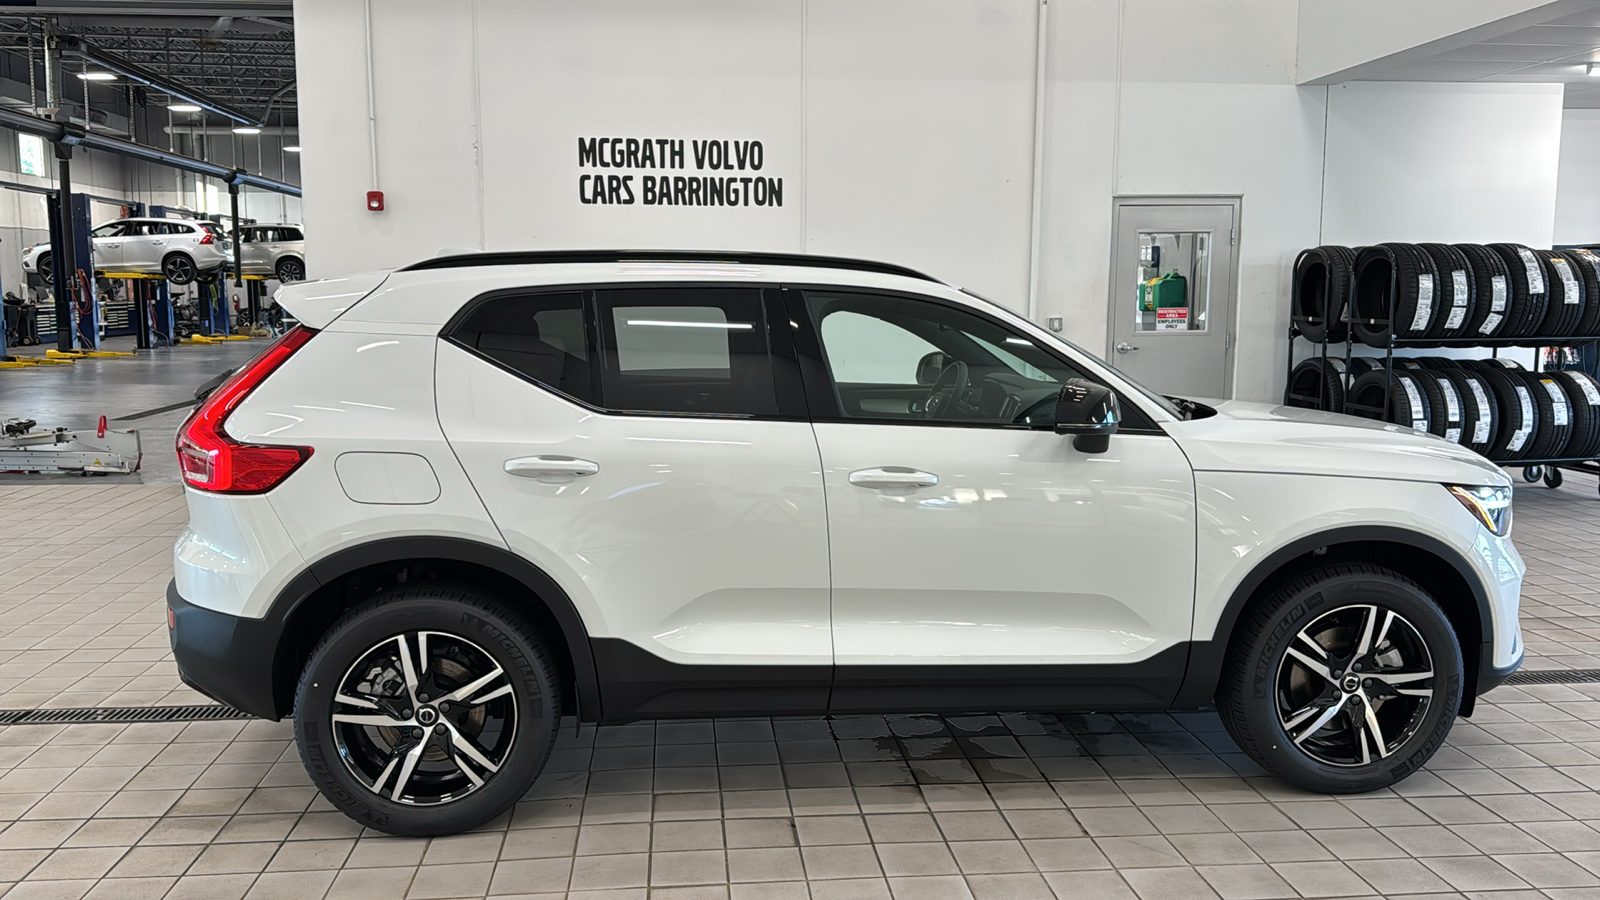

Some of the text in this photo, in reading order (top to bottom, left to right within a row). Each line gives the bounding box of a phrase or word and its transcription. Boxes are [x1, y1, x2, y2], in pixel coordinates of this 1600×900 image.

[578, 137, 763, 170] MCGRATH VOLVO
[579, 174, 783, 207] CARS BARRINGTON
[481, 624, 541, 695] MICHELIN
[1255, 604, 1306, 679] MICHELIN
[1410, 696, 1457, 769] MICHELIN
